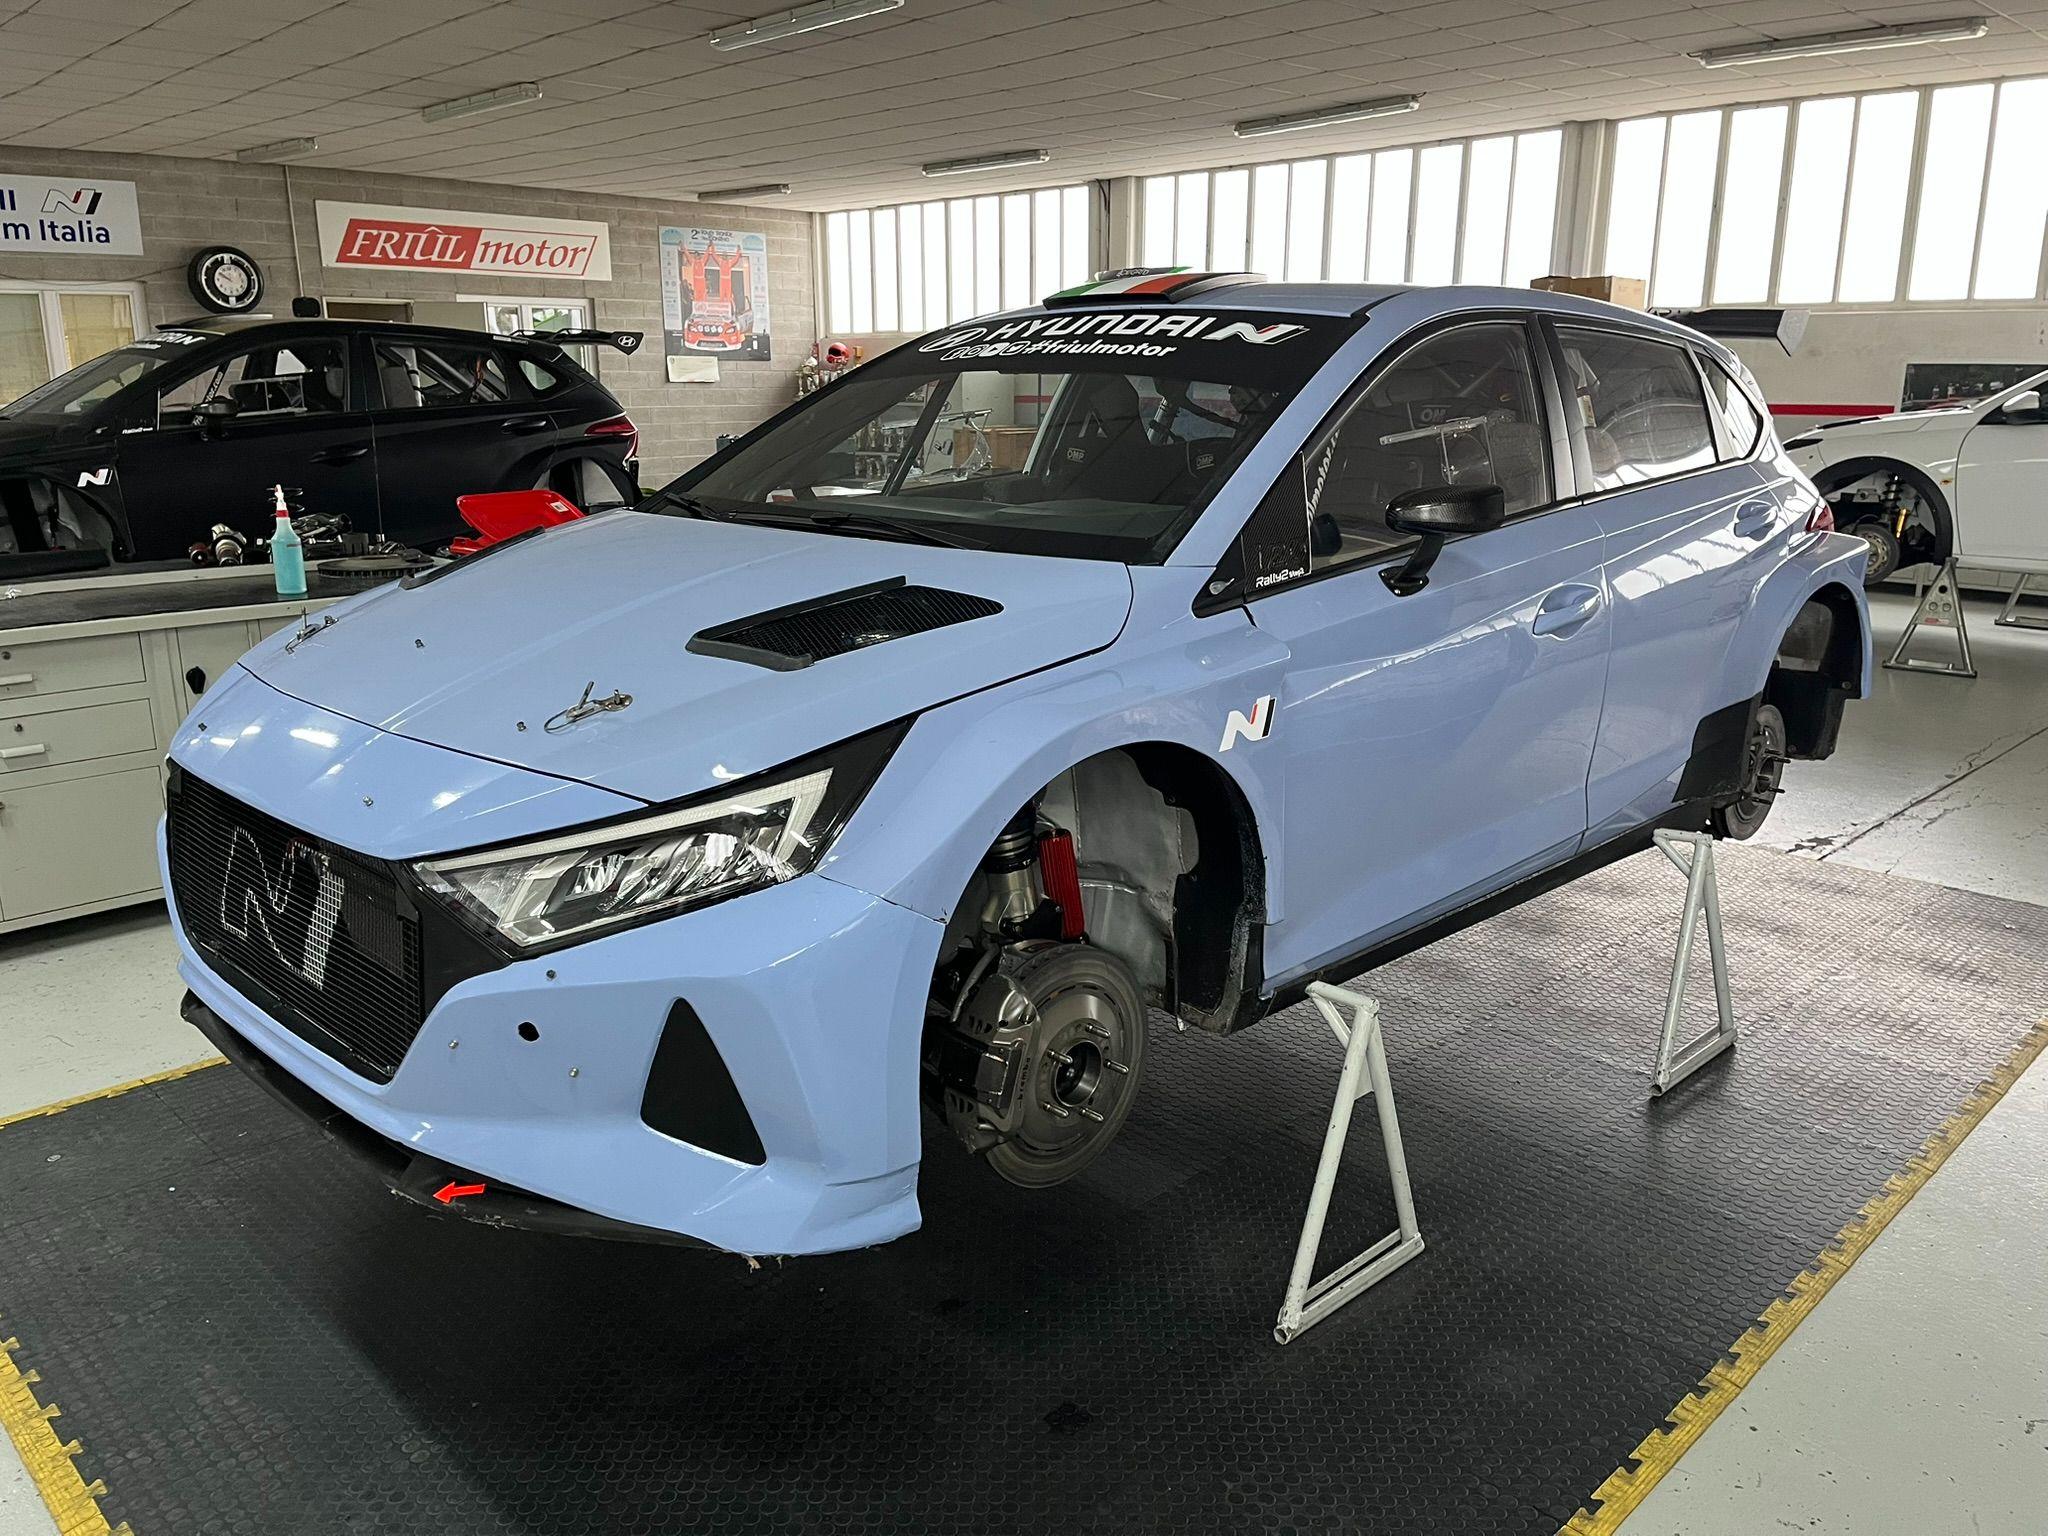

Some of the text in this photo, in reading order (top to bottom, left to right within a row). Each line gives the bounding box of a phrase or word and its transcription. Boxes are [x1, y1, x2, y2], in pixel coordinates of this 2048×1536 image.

[39, 219, 111, 244] Italia
[479, 239, 588, 269] motor
[982, 314, 1218, 342] HYUNDAI
[1022, 339, 1178, 357] #friulmotor
[1256, 568, 1289, 588] Rally2
